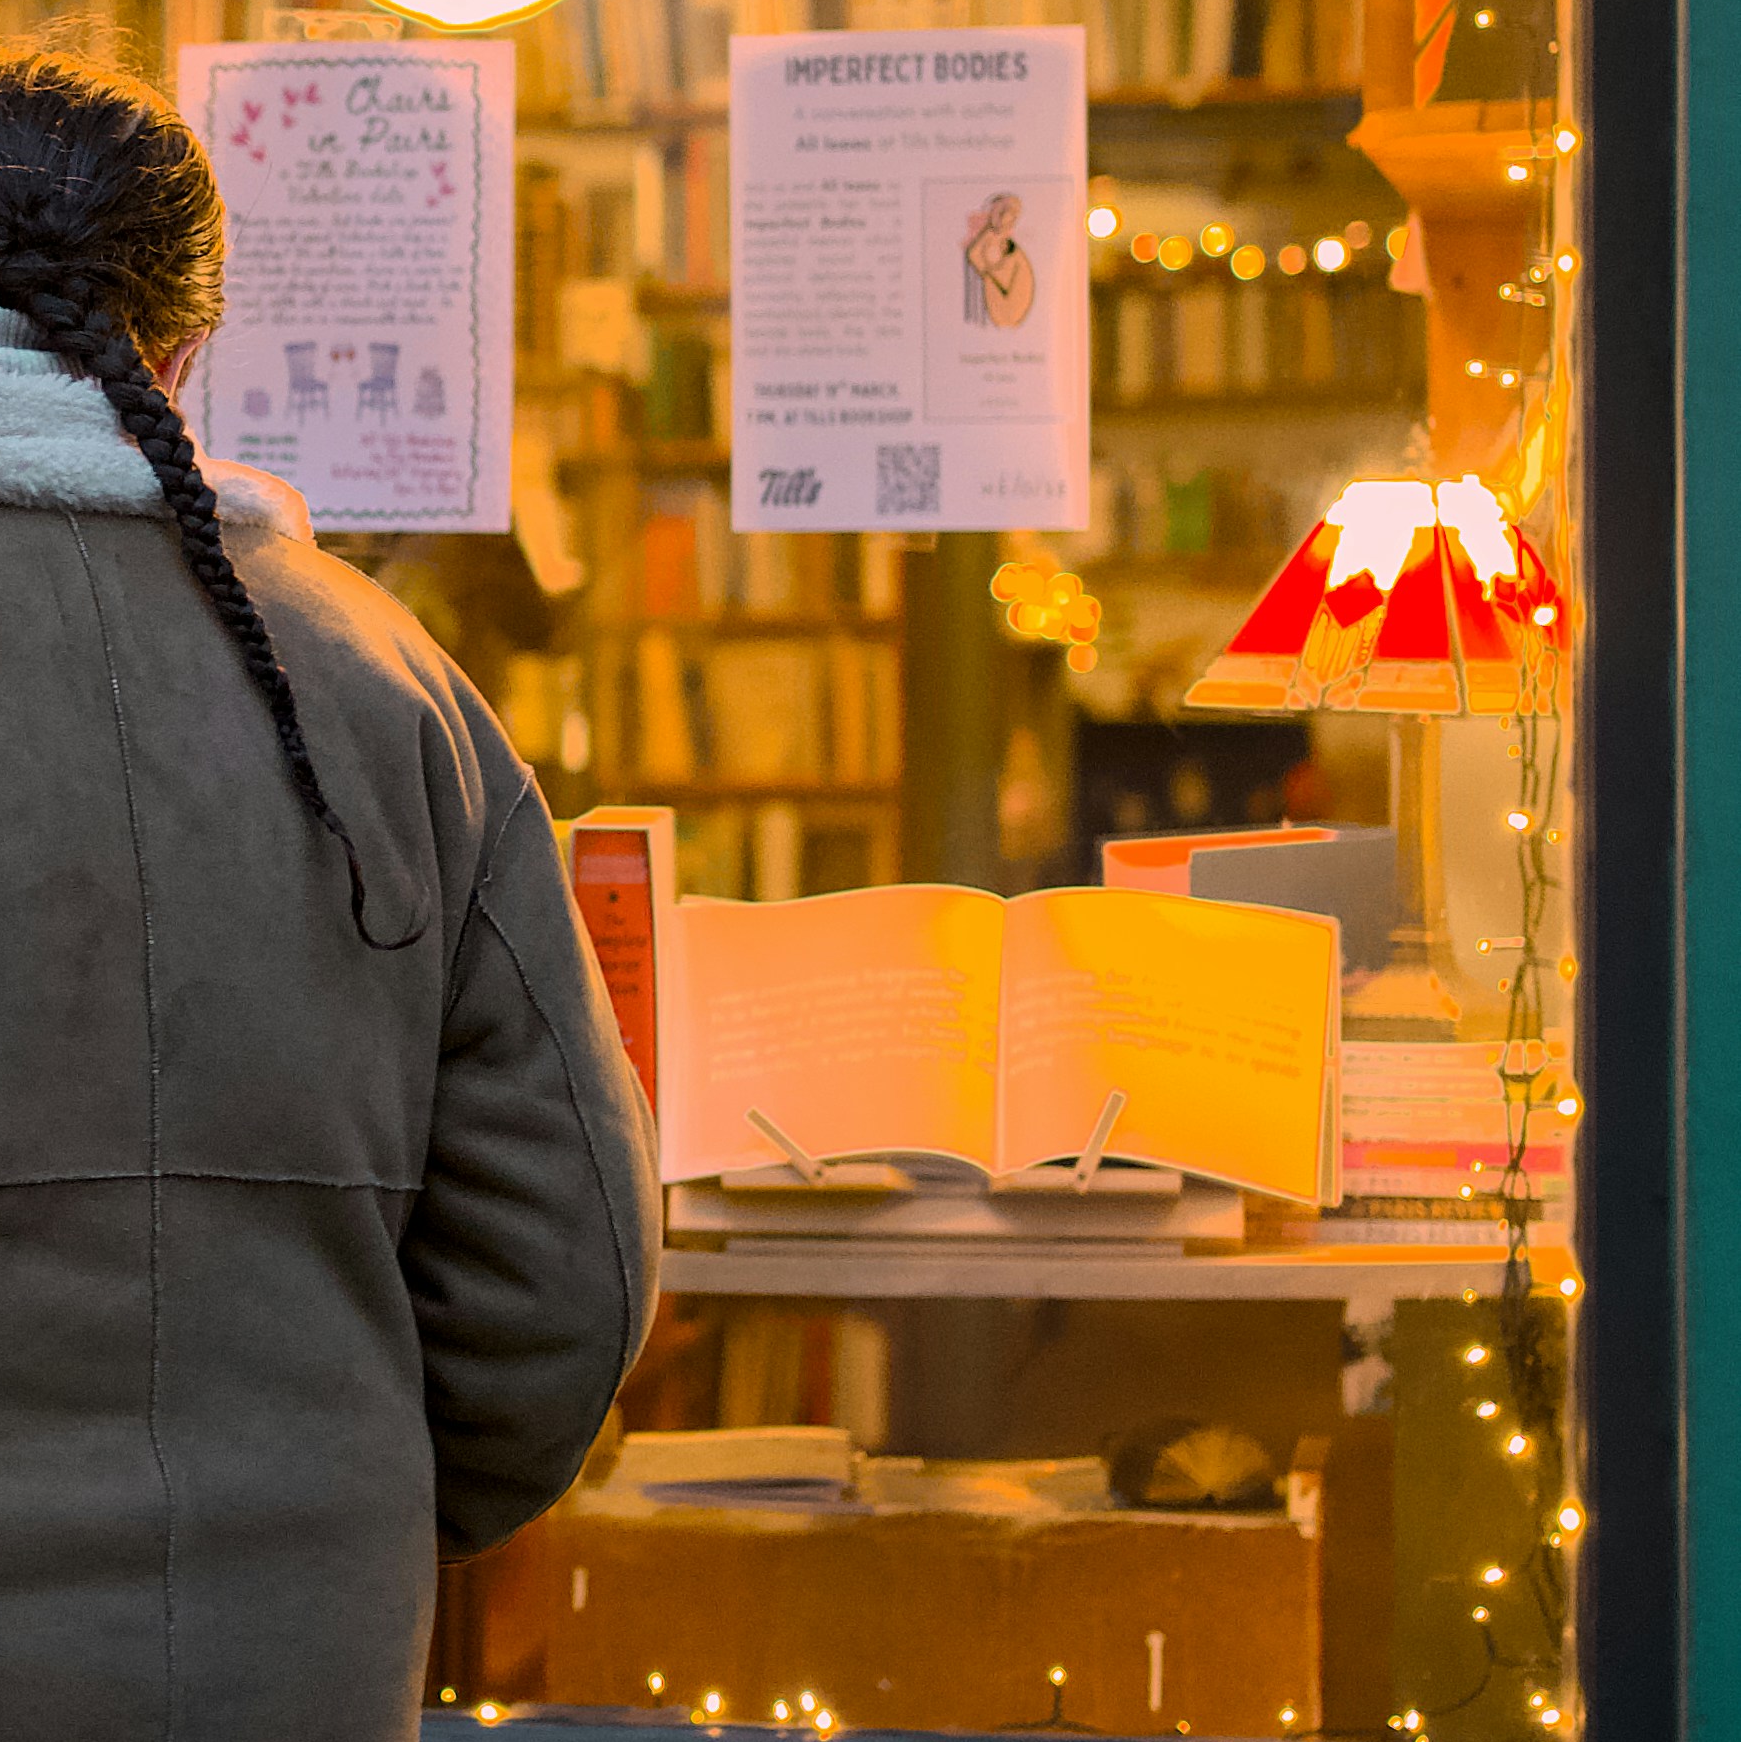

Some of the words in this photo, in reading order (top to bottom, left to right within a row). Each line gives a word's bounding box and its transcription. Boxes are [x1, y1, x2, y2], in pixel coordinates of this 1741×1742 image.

[784, 52, 926, 87] IMPERFECT
[932, 50, 1030, 84] BODIES
[345, 73, 452, 116] Chairs
[359, 115, 452, 154] Pairs
